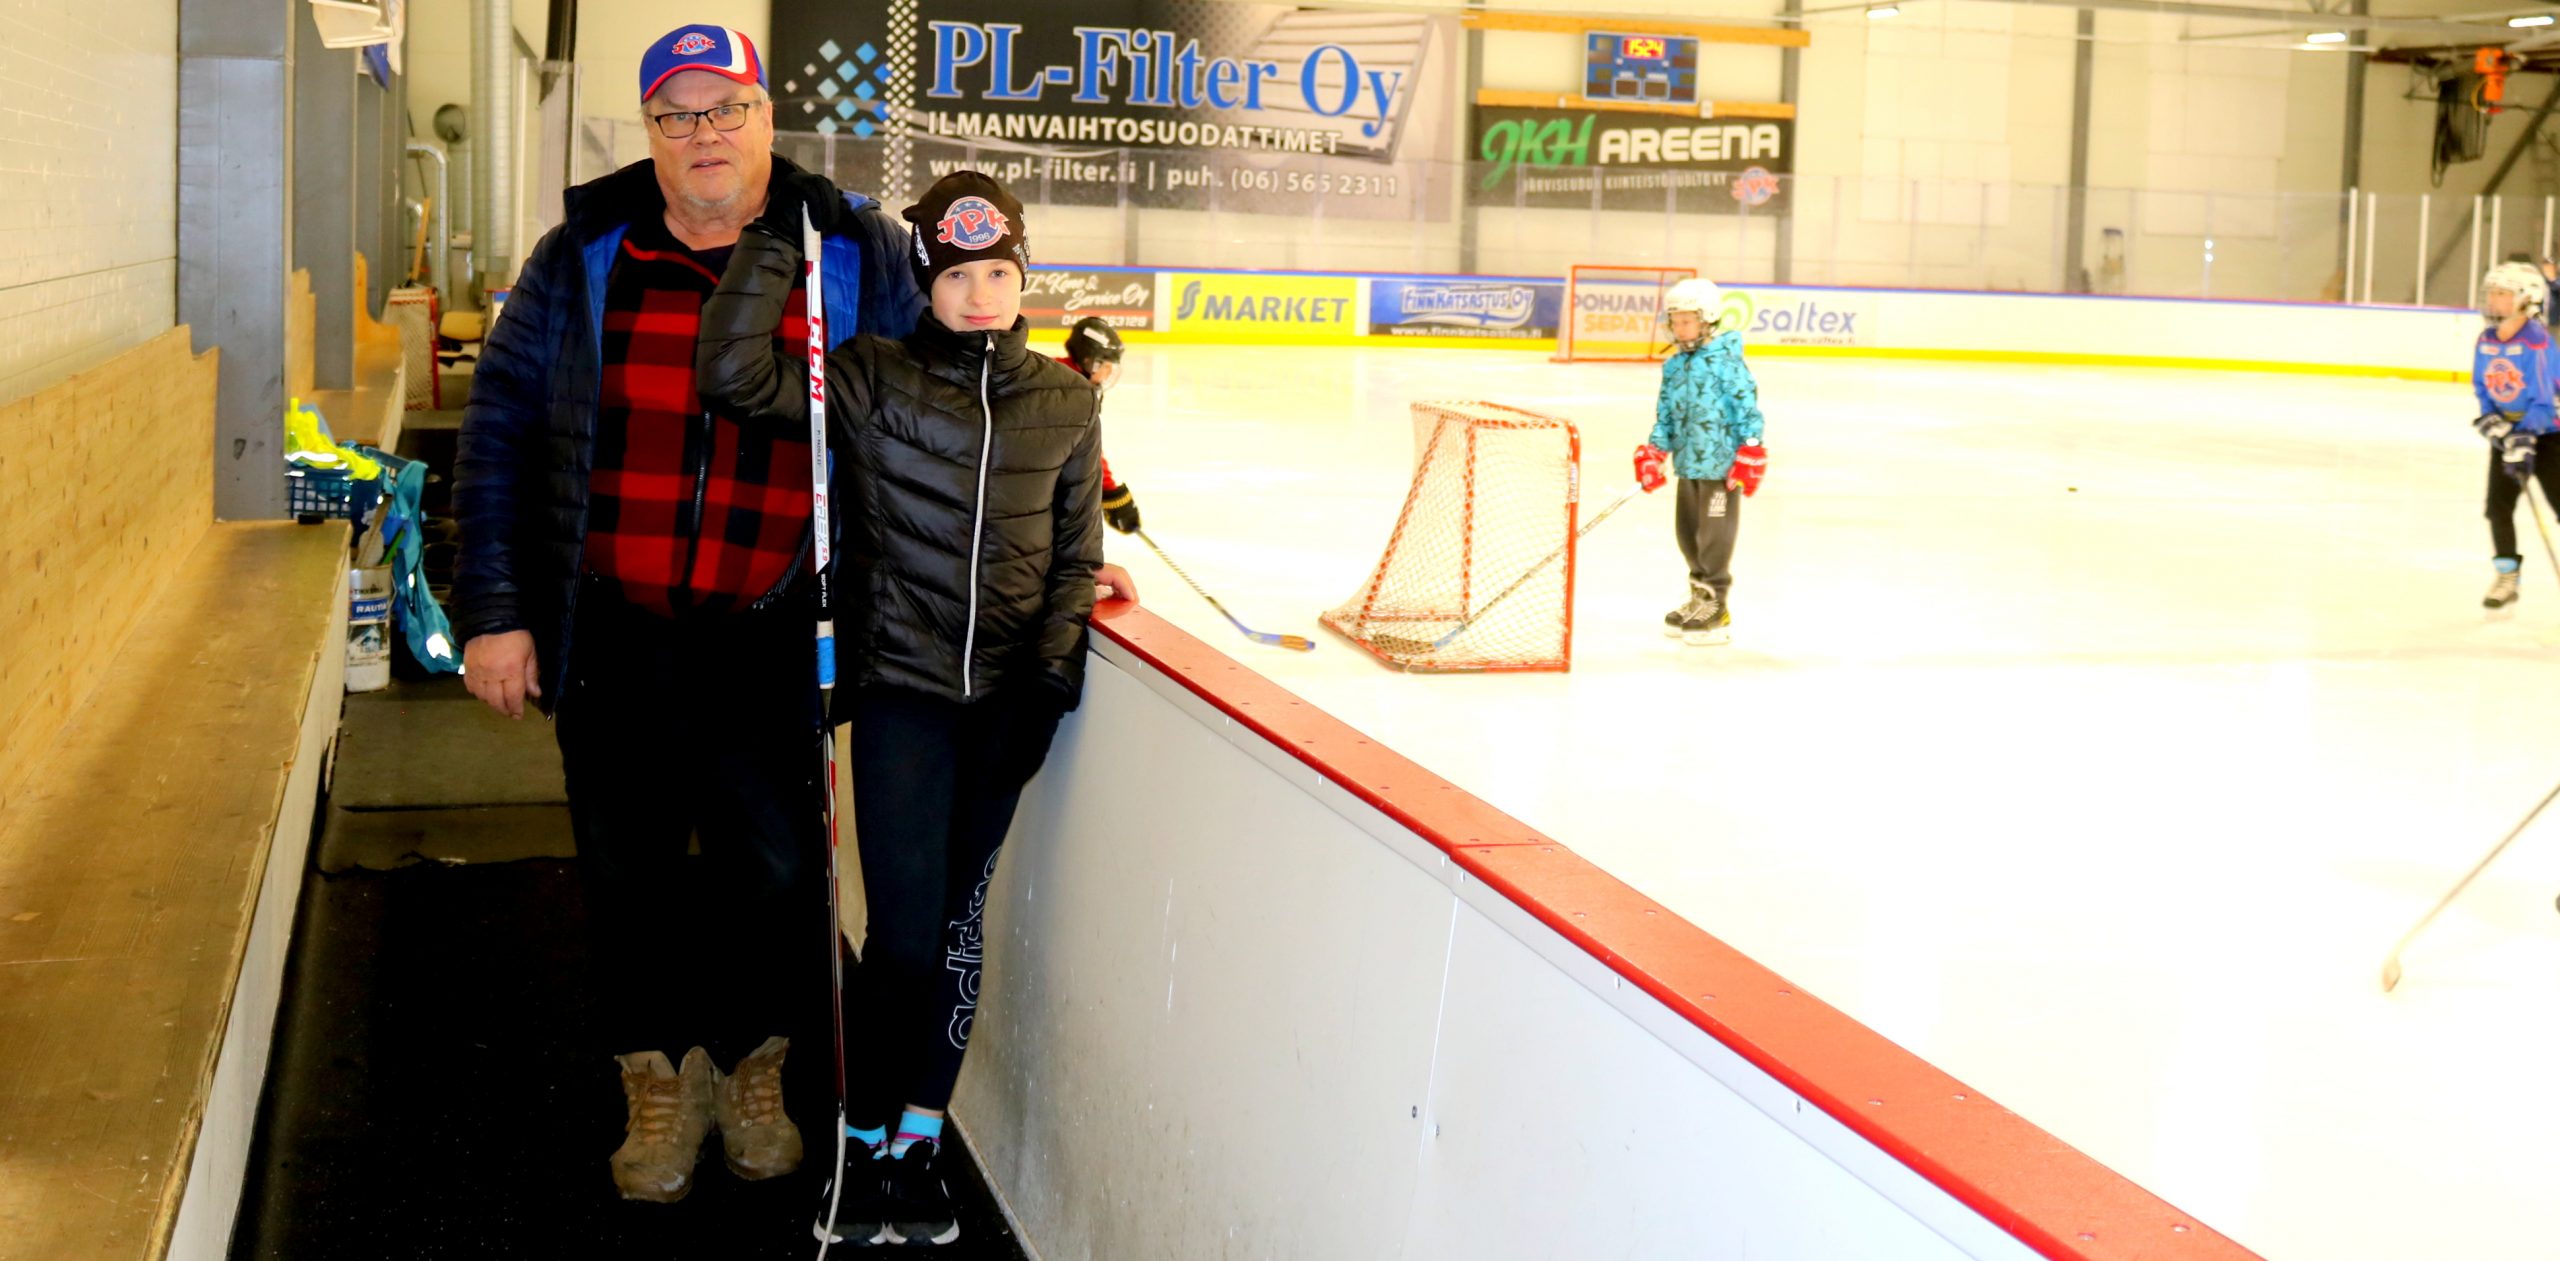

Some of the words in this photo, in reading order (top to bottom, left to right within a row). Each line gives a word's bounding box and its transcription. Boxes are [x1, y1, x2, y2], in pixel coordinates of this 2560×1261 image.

[672, 39, 716, 54] JPK
[926, 20, 1278, 110] PL-Filter
[1300, 44, 1401, 138] Oy
[927, 110, 1343, 154] ILMANVAIHTOSUODATTIMET
[1481, 114, 1597, 190] JKH
[1598, 124, 1781, 164] AREENA
[1231, 168, 1279, 191] (06)
[1286, 171, 1331, 192] 565
[1339, 174, 1398, 195] 2311
[1523, 174, 1598, 193] JÄRVISEUDU
[937, 206, 1011, 243] JPK
[968, 232, 991, 244] 1996
[1063, 287, 1122, 311] Service
[1121, 281, 1151, 307] Oy
[1085, 273, 1099, 291] &
[1202, 296, 1349, 323] MARKET
[1749, 302, 1858, 334] saltex
[810, 316, 824, 403] CCM
